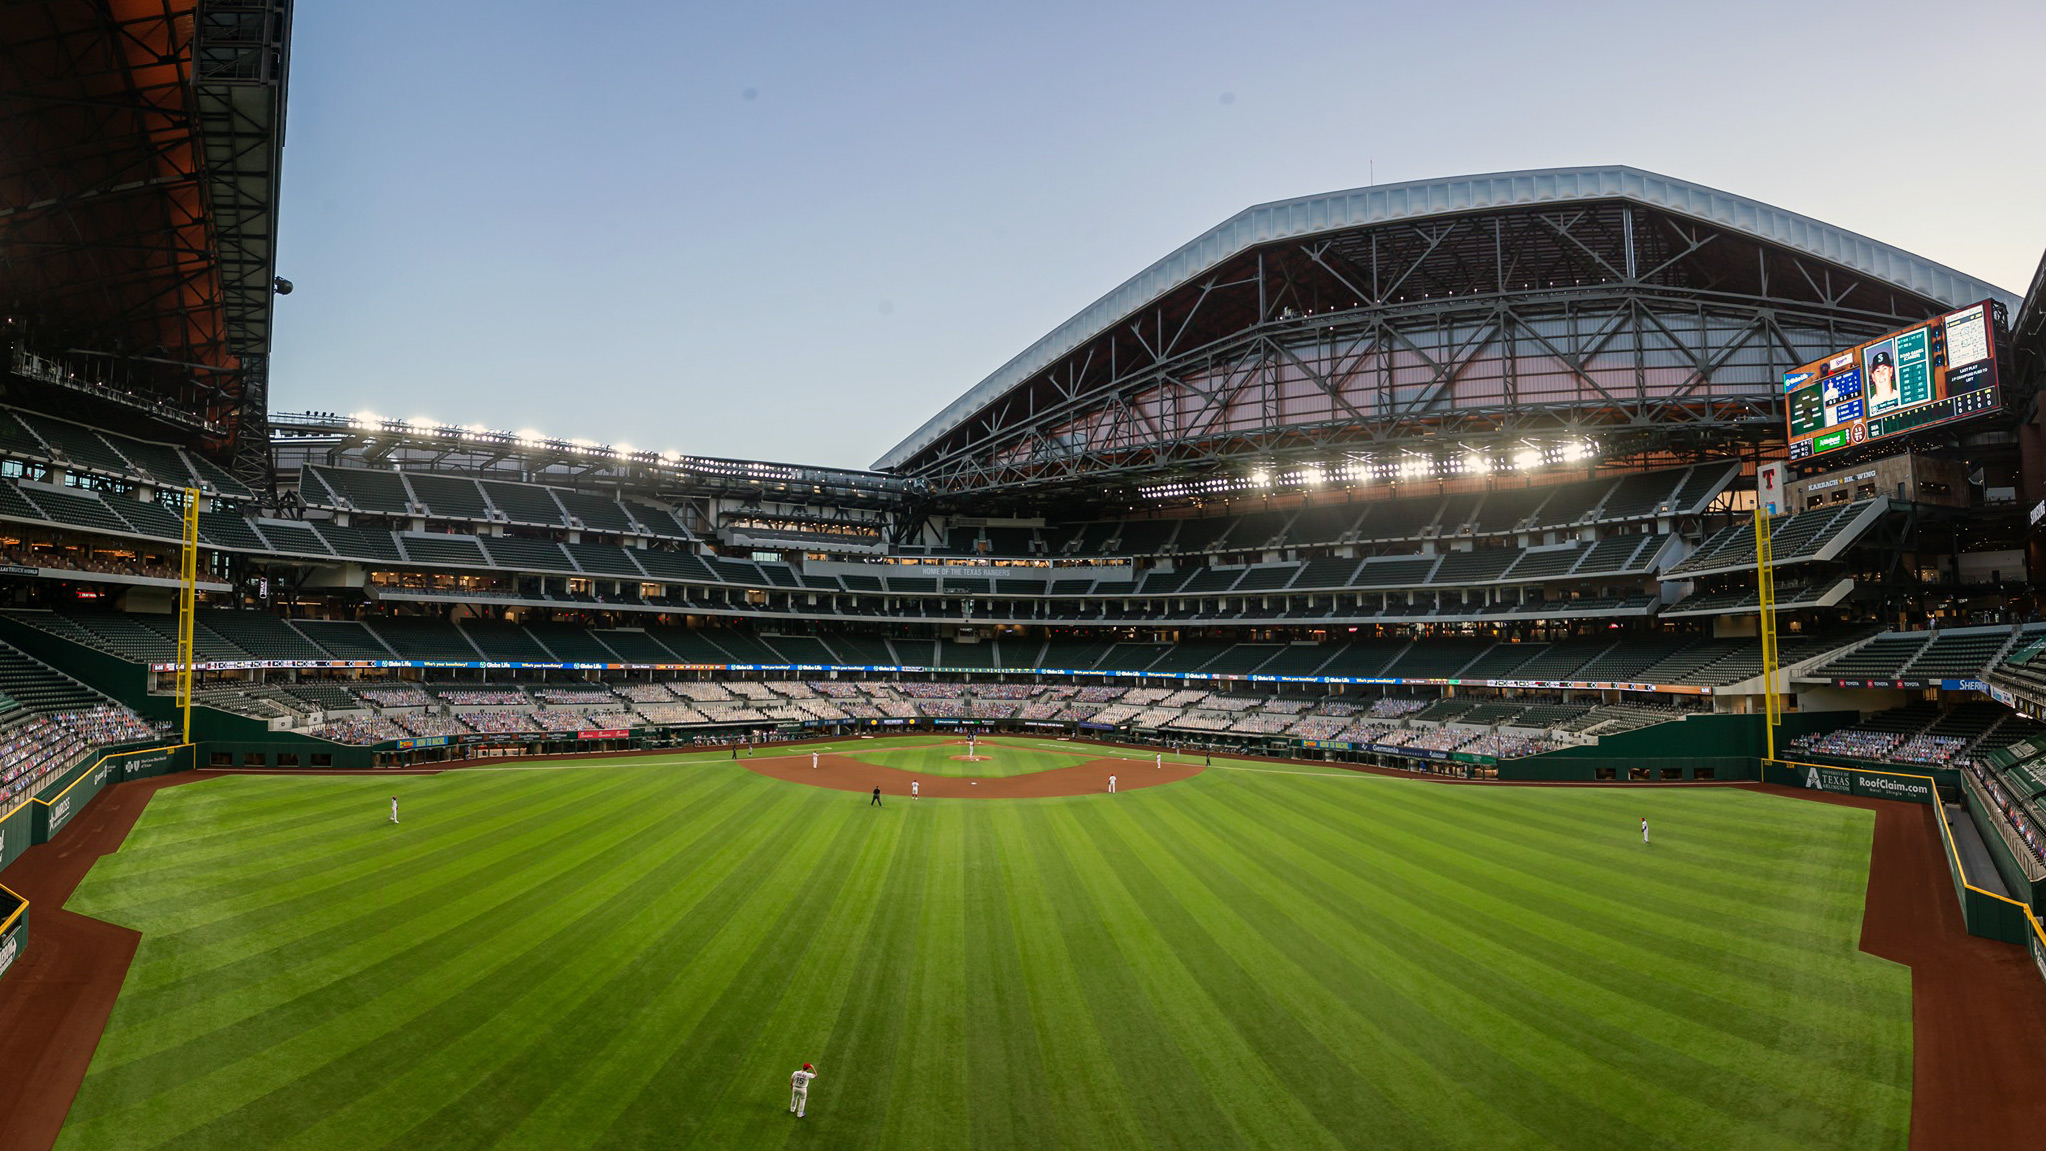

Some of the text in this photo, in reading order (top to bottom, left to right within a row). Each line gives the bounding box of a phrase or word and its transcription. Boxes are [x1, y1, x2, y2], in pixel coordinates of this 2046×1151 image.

[1763, 468, 1775, 490] T
[1808, 470, 1876, 491] KARBACH BRWING
[1372, 744, 1399, 753] Germania
[1822, 775, 1849, 786] TEXAS
[1859, 777, 1928, 794] RoofClaim.com
